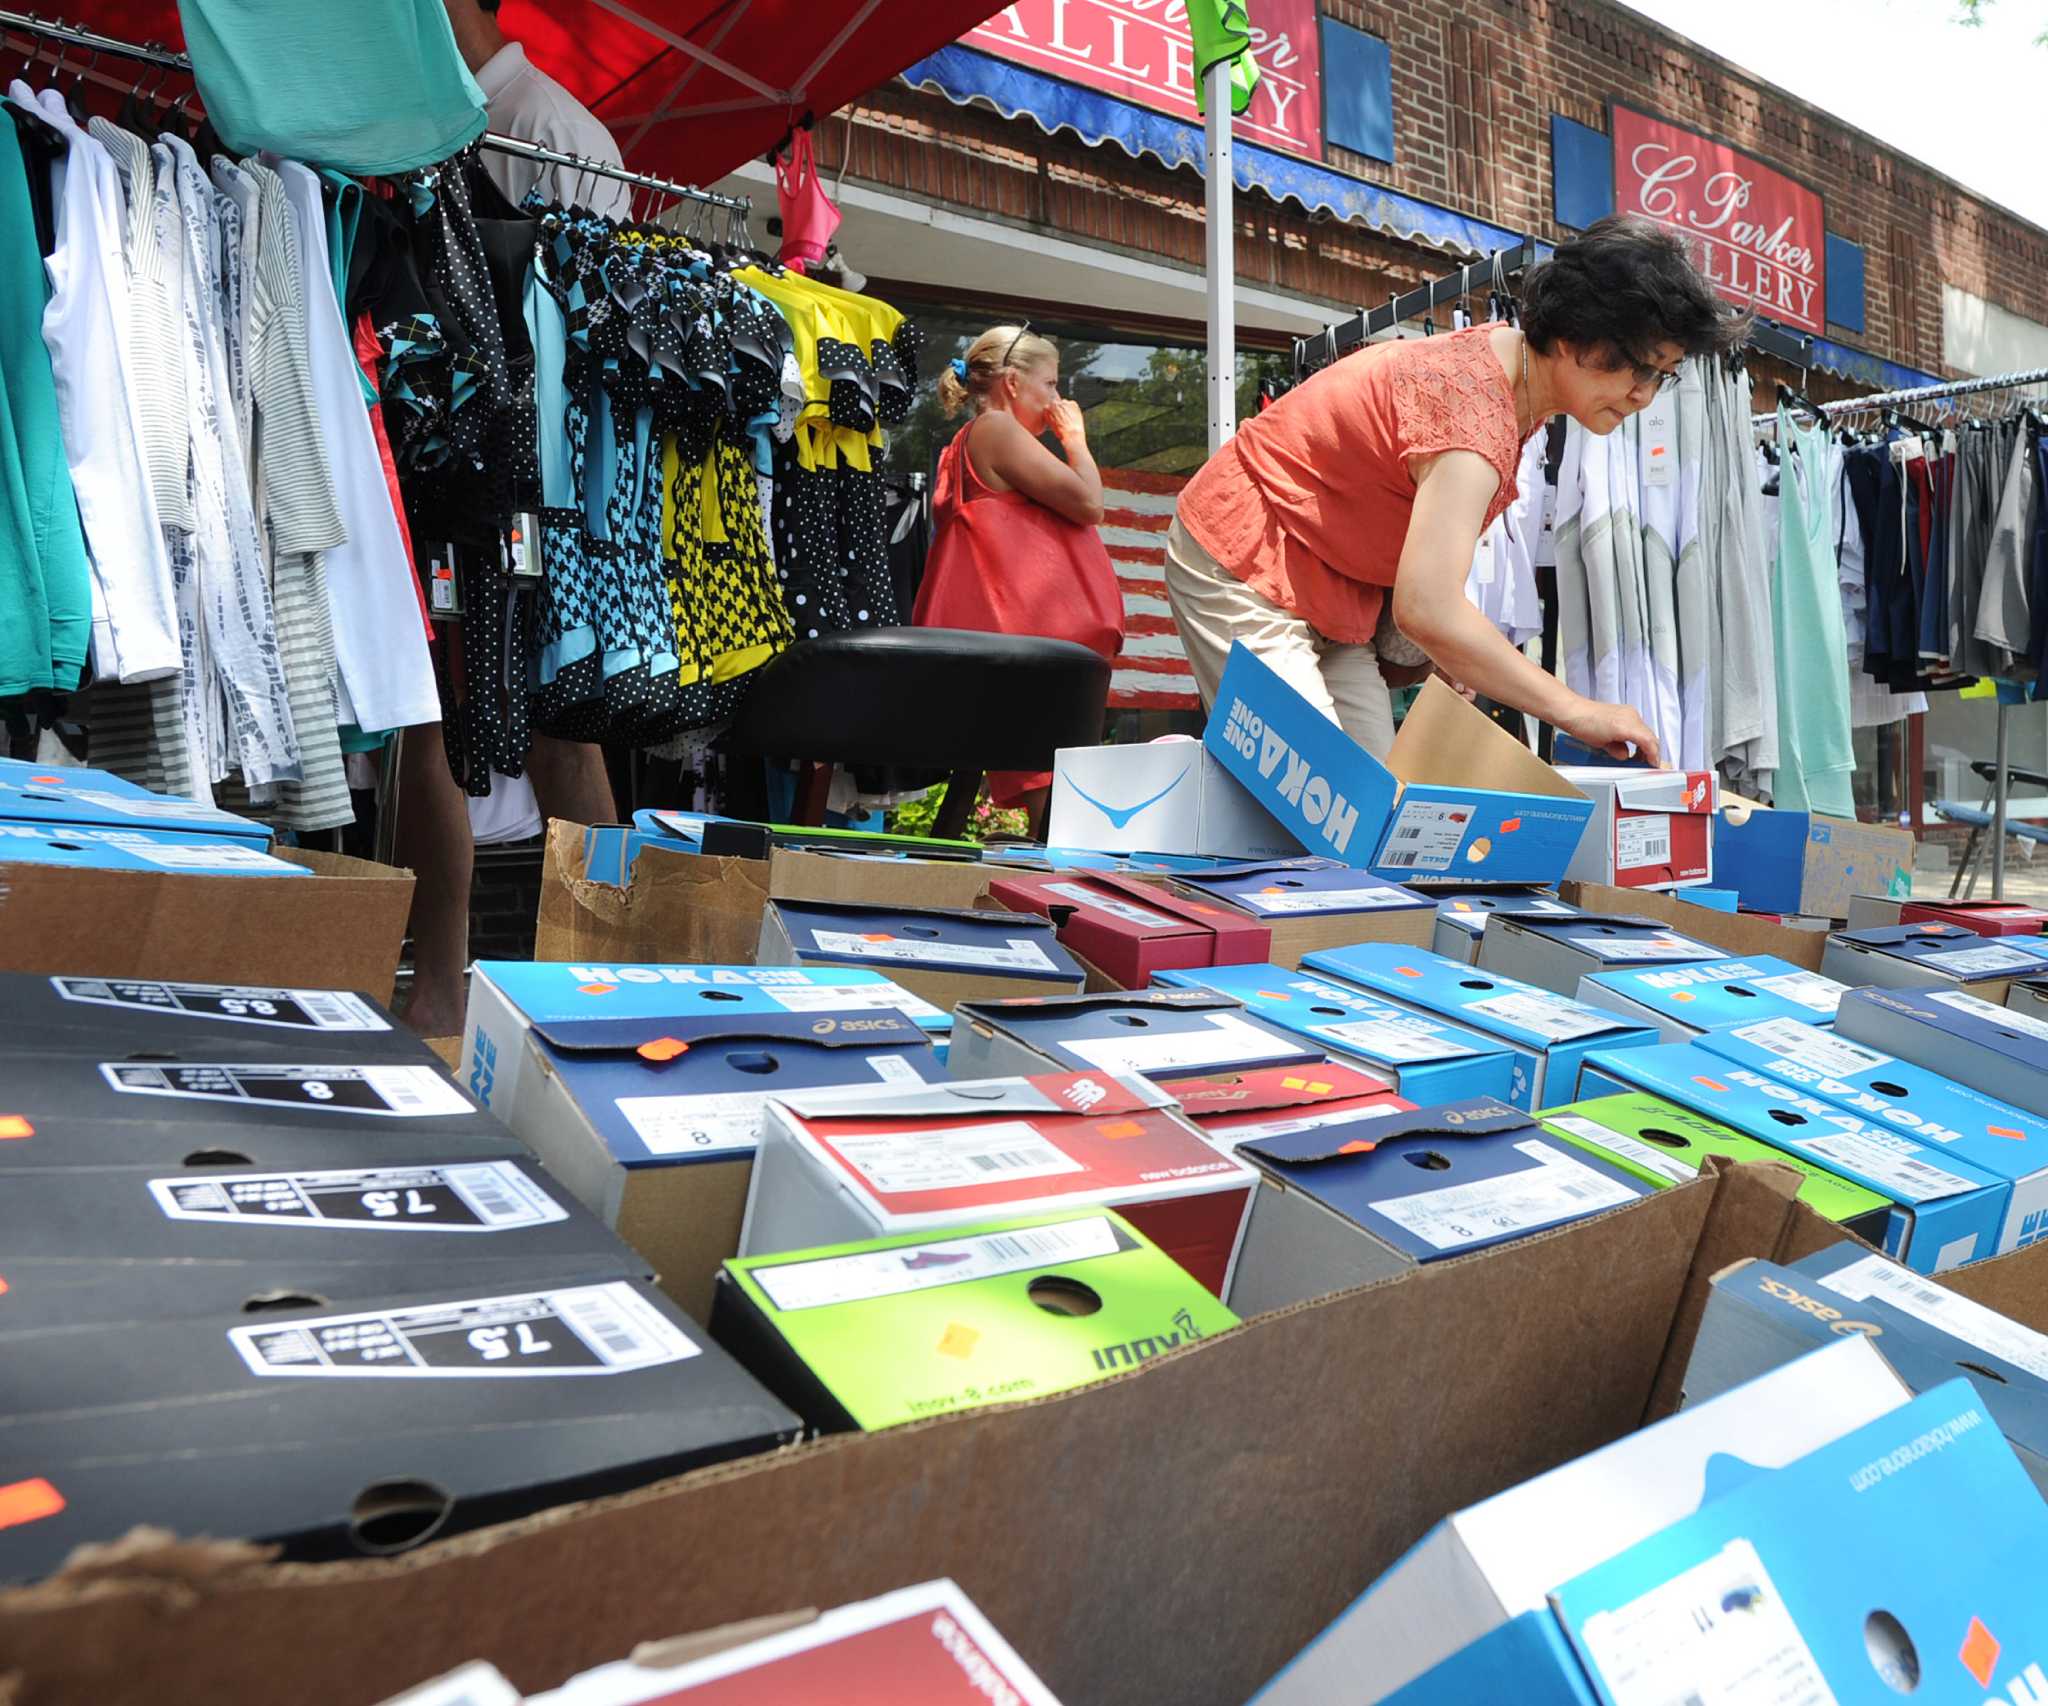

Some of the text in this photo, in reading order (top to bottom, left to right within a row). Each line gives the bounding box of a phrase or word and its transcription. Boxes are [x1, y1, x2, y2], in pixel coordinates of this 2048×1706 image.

[1688, 172, 1815, 274] Parker
[1230, 696, 1263, 739] ONE
[1222, 718, 1256, 760] ONE
[1257, 724, 1360, 855] HOKA
[568, 967, 756, 985] HOKA
[220, 998, 278, 1016] 8.5
[841, 1019, 899, 1032] asics
[301, 1080, 334, 1101] 8
[1724, 1071, 1865, 1134] HOKA
[1461, 1105, 1510, 1121] asics
[1817, 1077, 1964, 1143] HOKA
[691, 1131, 711, 1145] 8
[361, 1190, 436, 1217] 7.5
[1450, 1224, 1472, 1238] 8
[1758, 1276, 1843, 1322] asics
[468, 1323, 552, 1361] 7.5
[1849, 1407, 1982, 1492] www.hokaoneone.com
